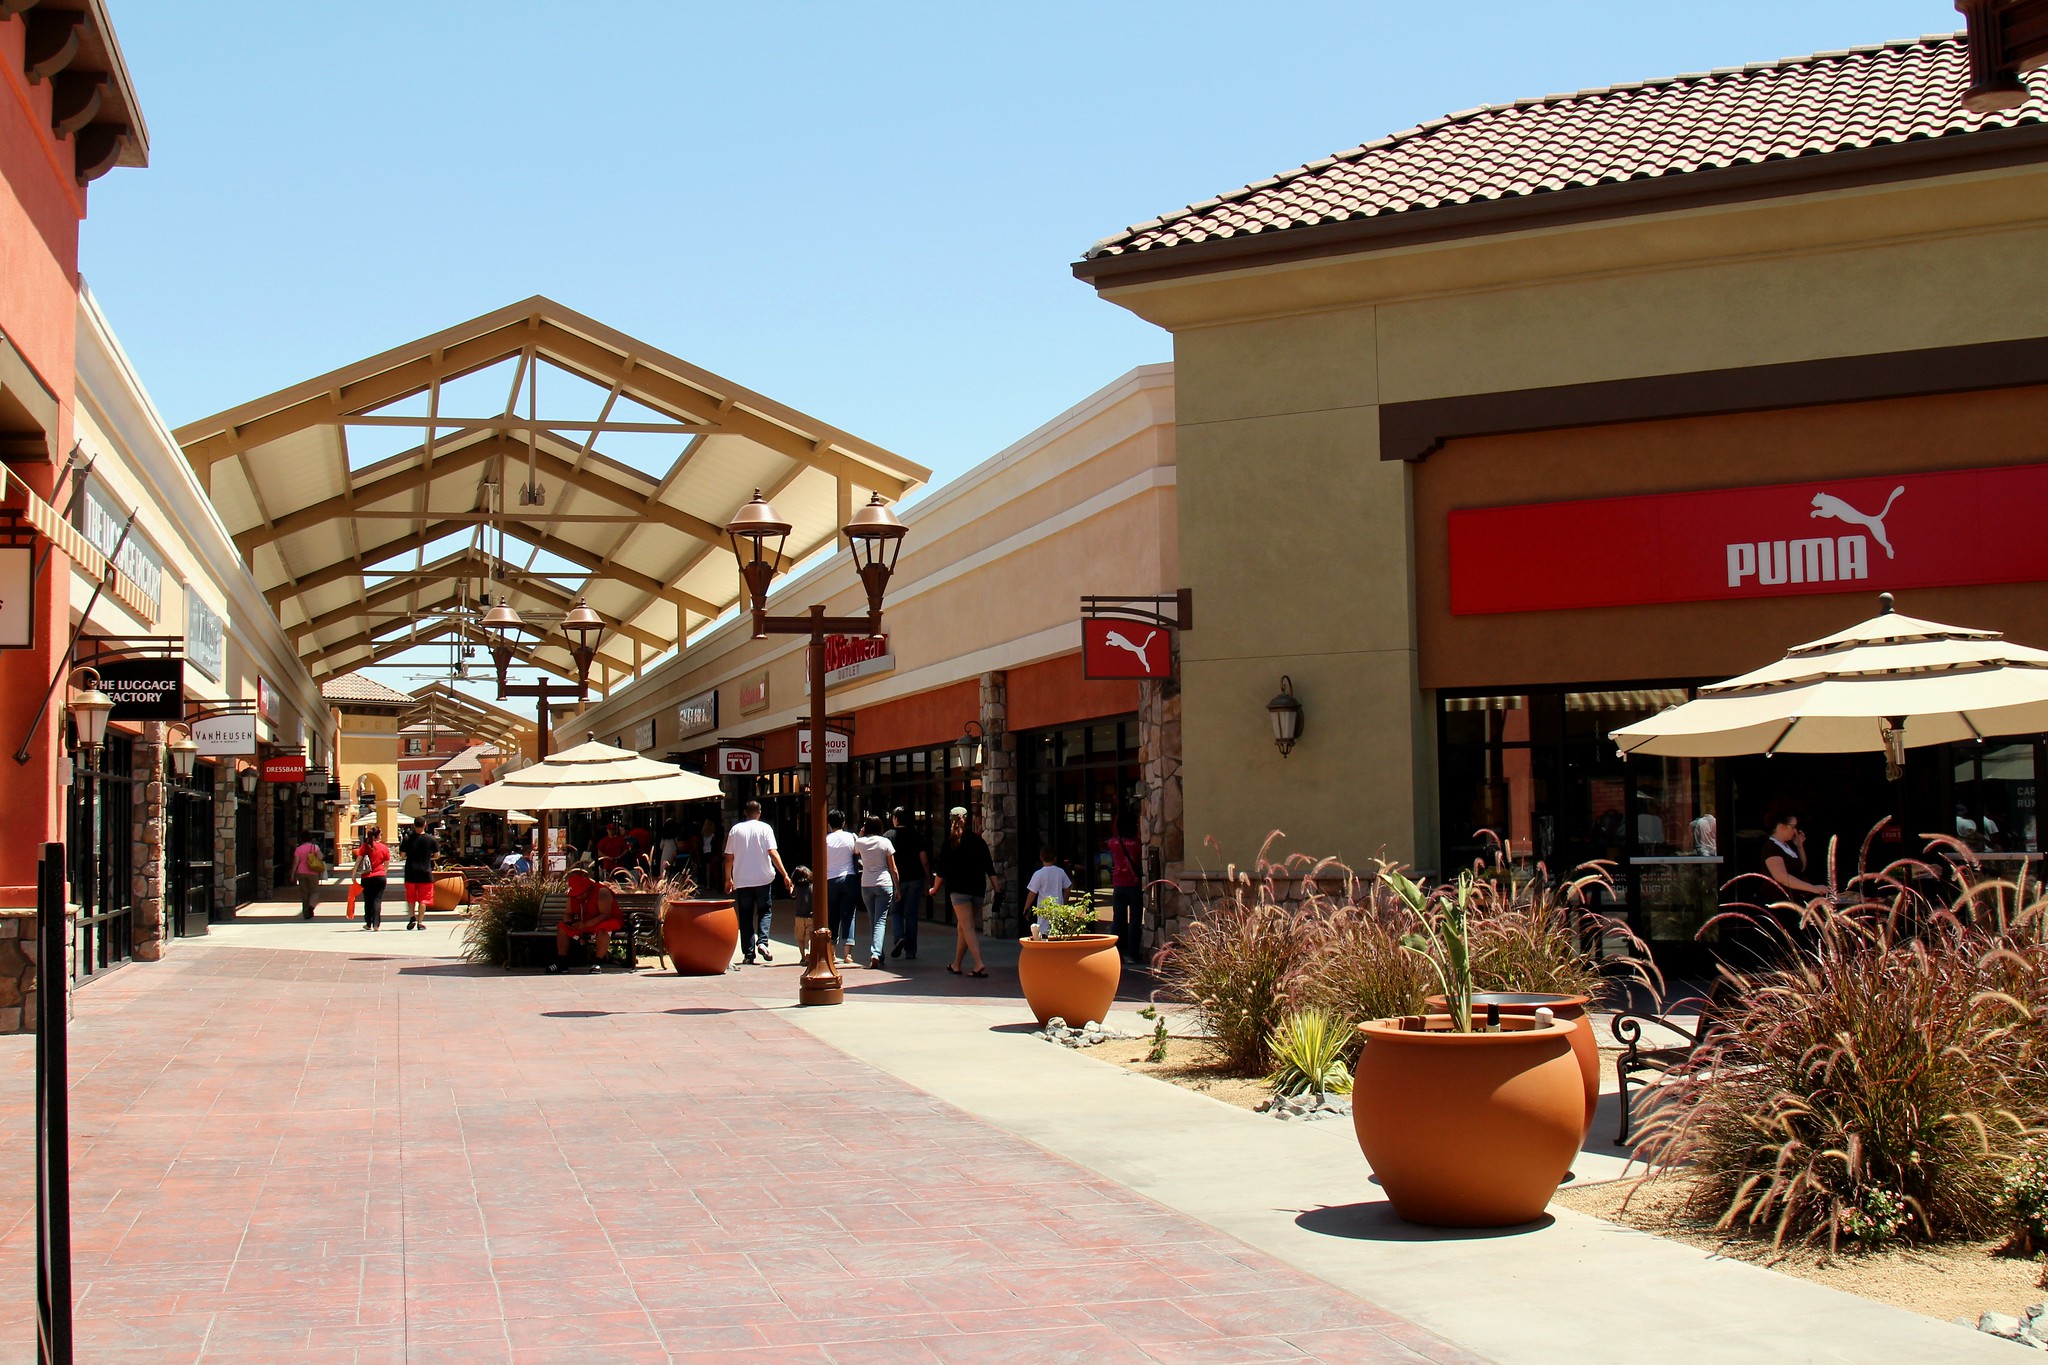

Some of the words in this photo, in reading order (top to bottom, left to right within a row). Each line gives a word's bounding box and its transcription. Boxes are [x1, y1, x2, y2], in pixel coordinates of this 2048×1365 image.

[1726, 535, 1868, 588] PUMA
[838, 664, 860, 680] OUTLET
[118, 680, 176, 690] LUGGAGE
[107, 692, 163, 702] FACTORY
[825, 740, 846, 748] MOUS
[728, 758, 751, 770] TV
[403, 774, 420, 791] H&M
